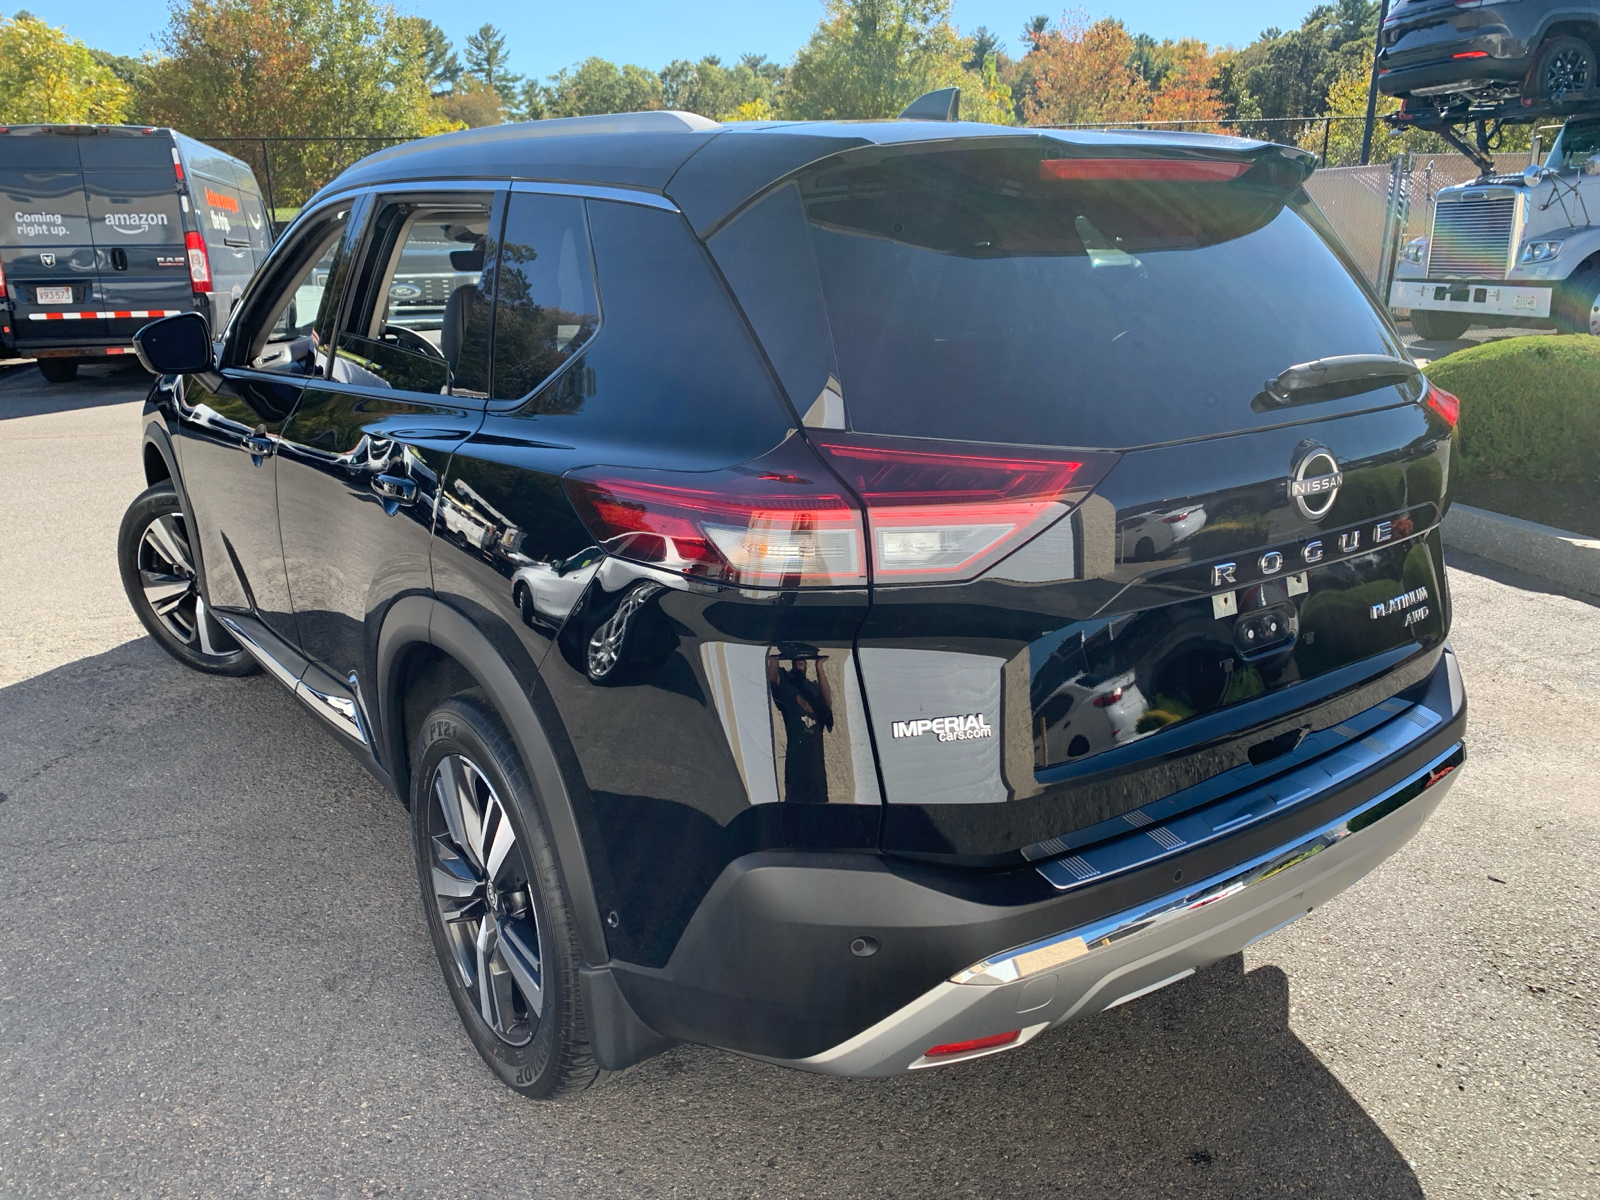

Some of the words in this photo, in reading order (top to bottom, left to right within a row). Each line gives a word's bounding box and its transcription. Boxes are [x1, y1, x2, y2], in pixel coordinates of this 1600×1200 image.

[14, 211, 62, 225] Coming
[104, 213, 168, 226] amazon
[17, 224, 49, 237] right
[50, 225, 70, 236] up.
[1294, 475, 1343, 495] NISSAN
[1211, 520, 1392, 587] ROGUE
[1370, 586, 1429, 619] PLATINUM
[1402, 606, 1429, 627] AWD
[892, 713, 991, 738] IMPERIAL
[937, 728, 991, 742] cars.com
